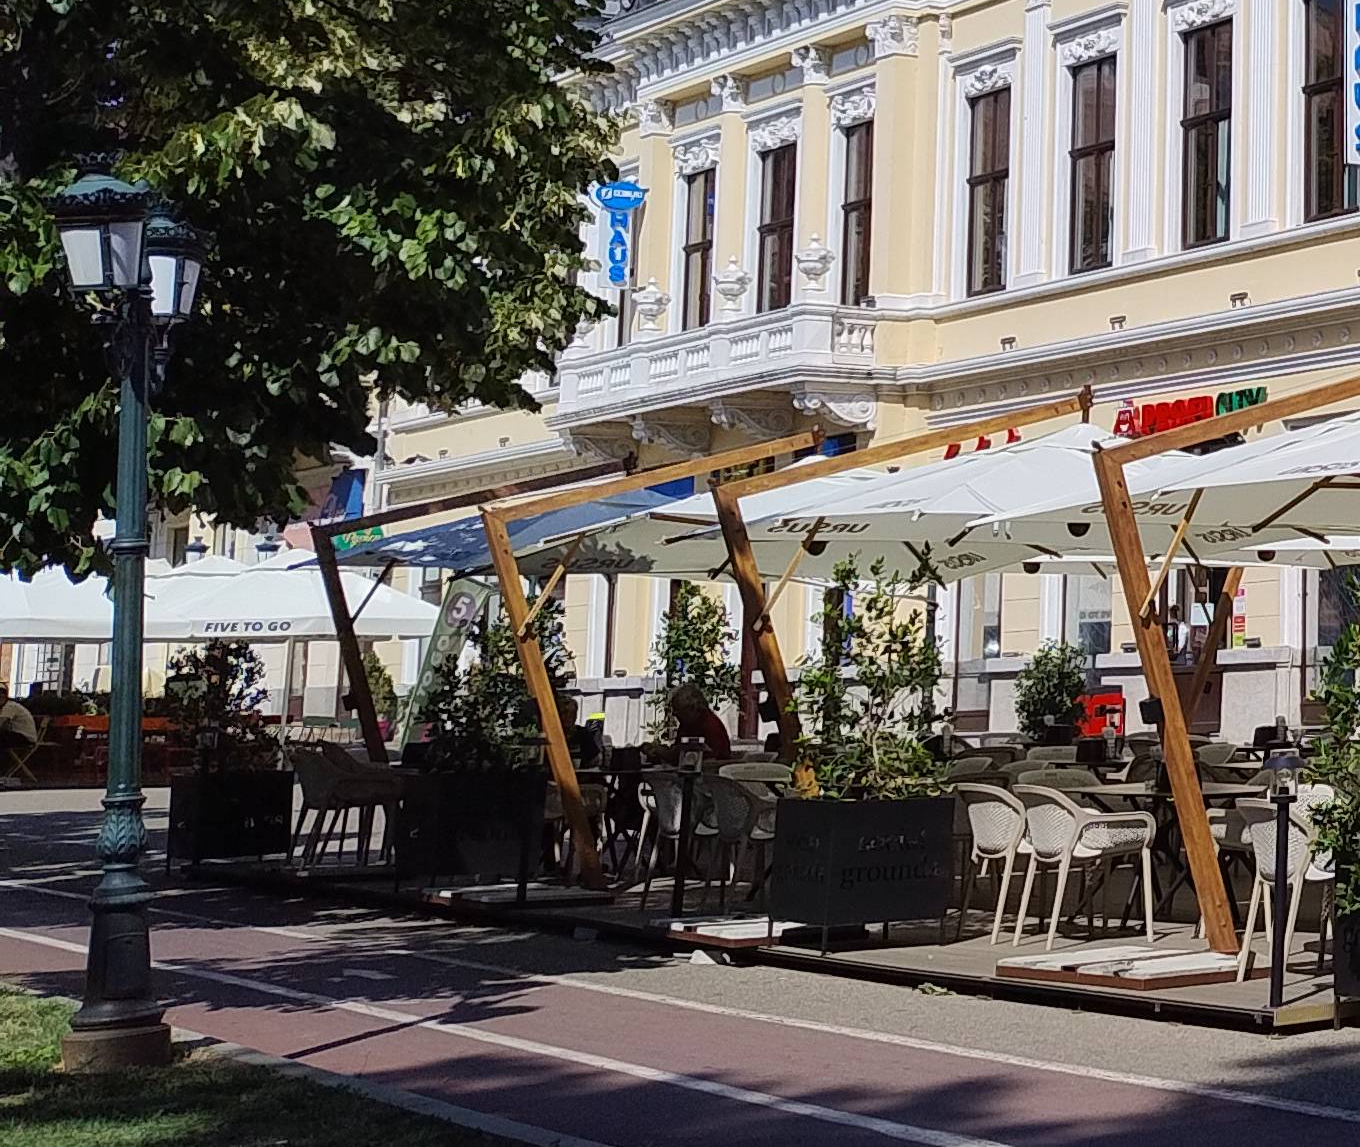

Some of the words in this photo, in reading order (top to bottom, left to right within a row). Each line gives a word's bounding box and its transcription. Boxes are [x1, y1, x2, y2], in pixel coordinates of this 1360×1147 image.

[609, 211, 628, 281] HAUS
[452, 596, 471, 618] 5
[205, 622, 240, 632] FIVE
[244, 622, 263, 631] TO
[268, 621, 292, 631] GO
